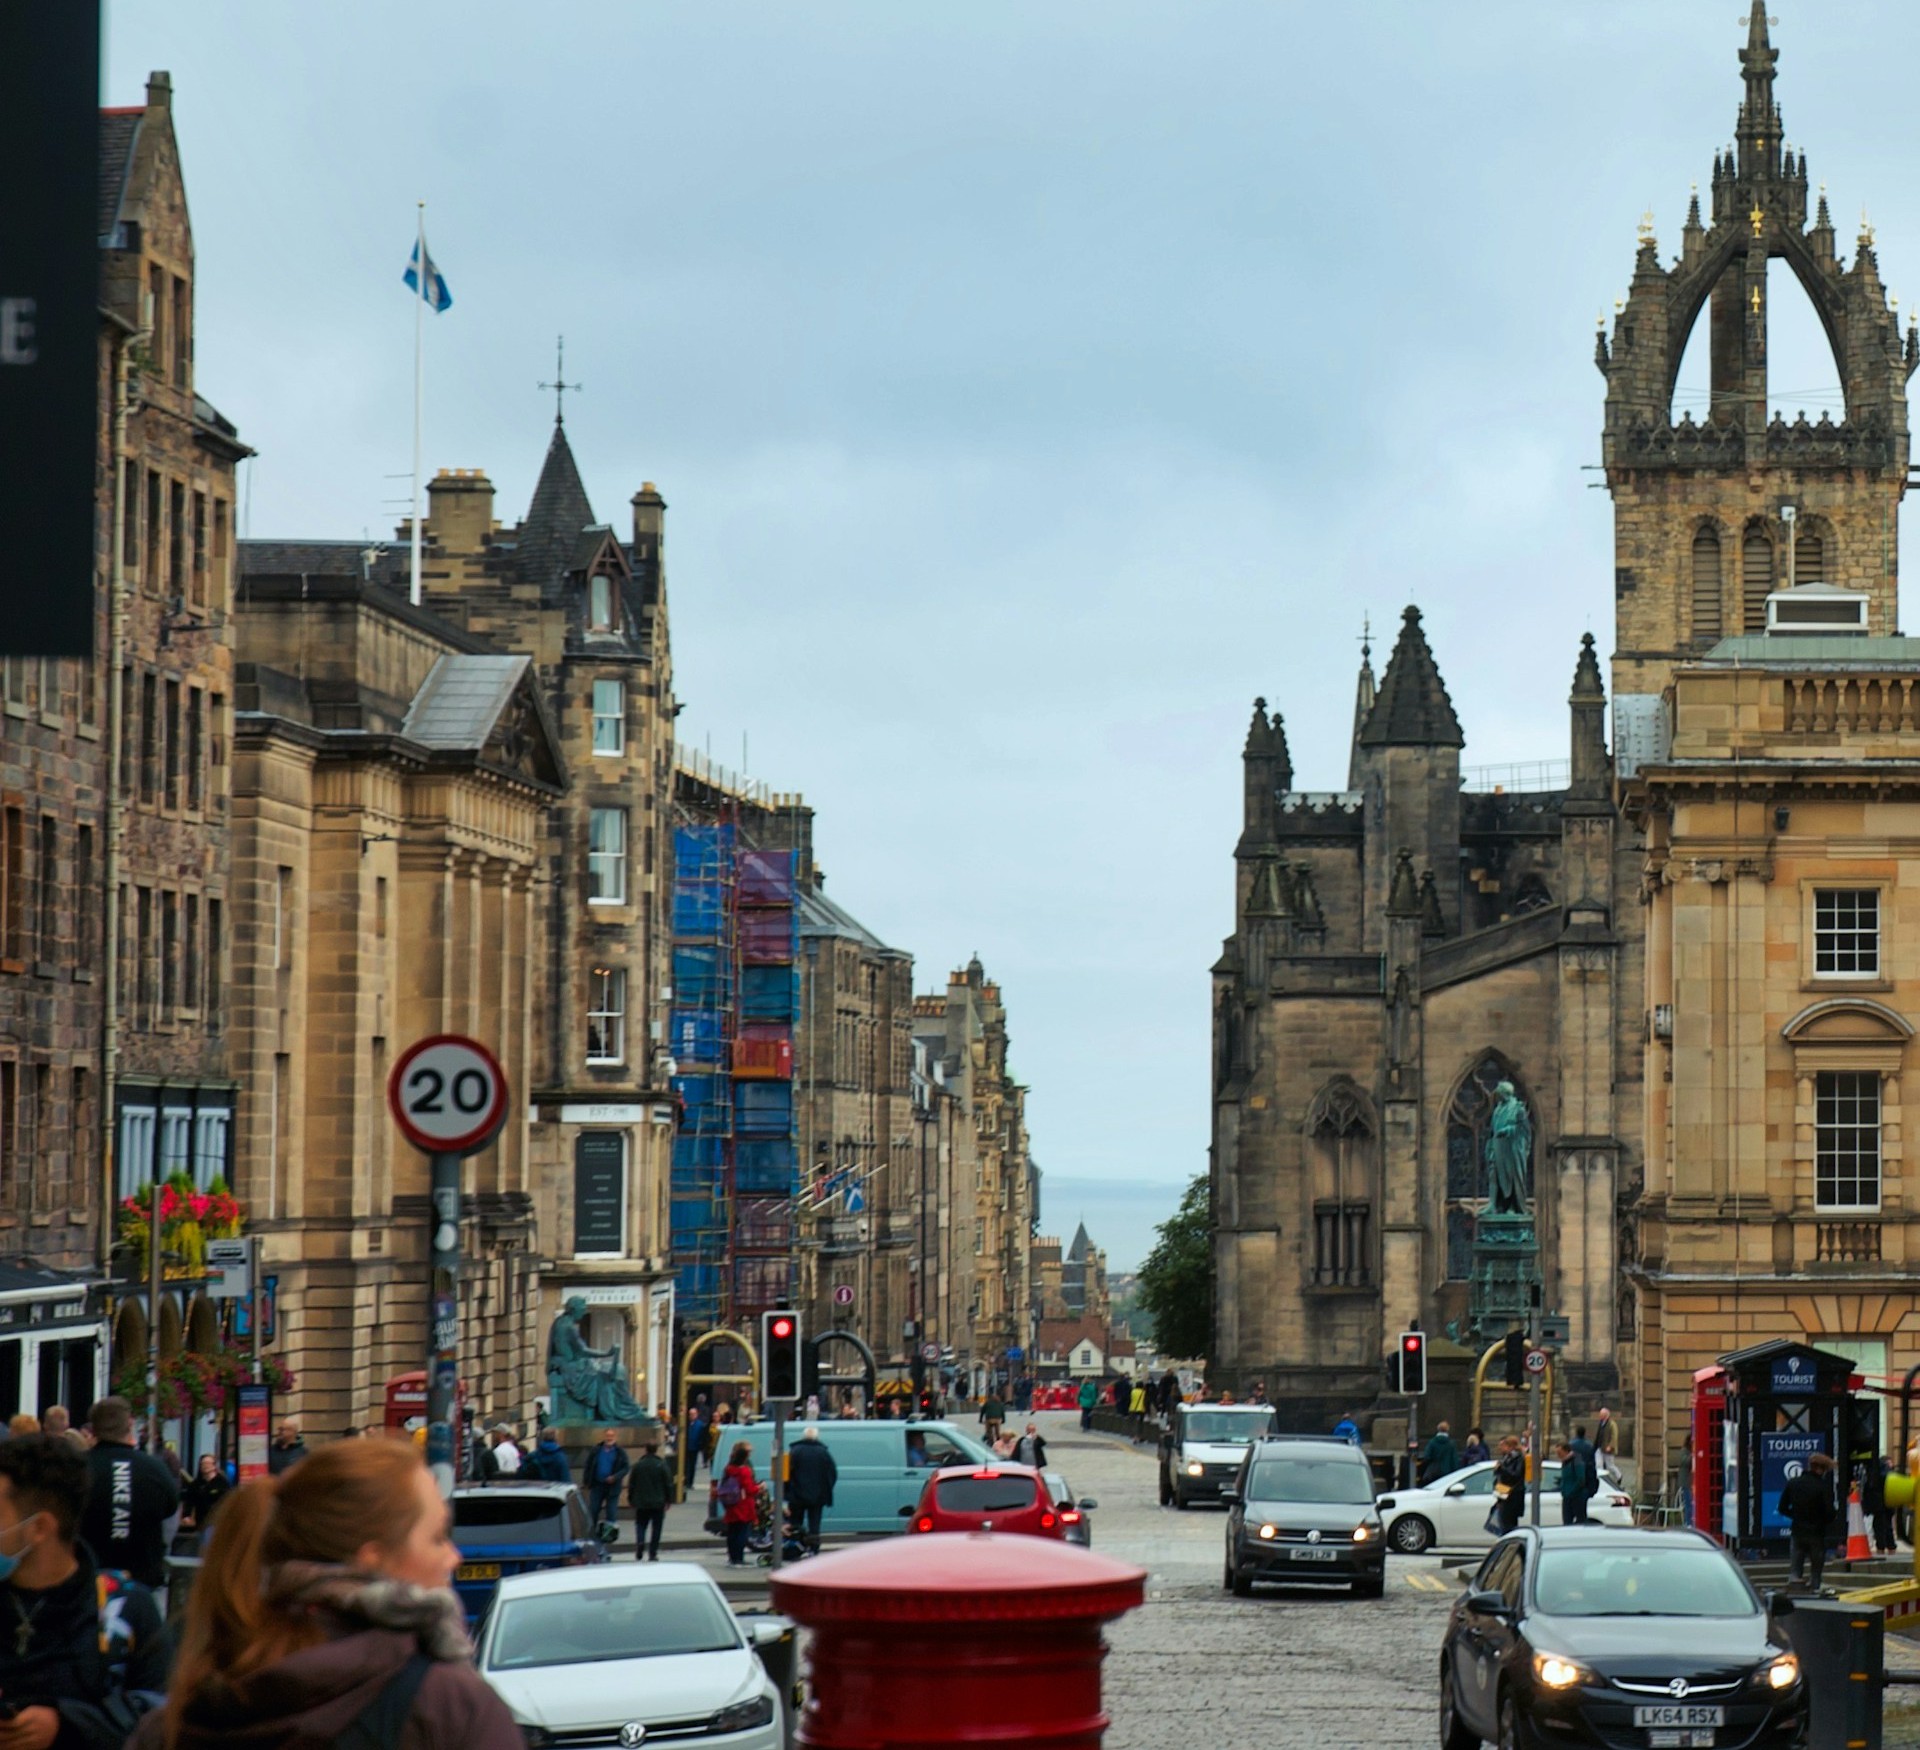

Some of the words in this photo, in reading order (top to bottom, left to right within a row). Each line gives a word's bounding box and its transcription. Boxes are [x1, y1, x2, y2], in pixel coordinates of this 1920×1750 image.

[408, 1067, 488, 1115] 20
[1528, 1356, 1544, 1367] 20
[1773, 1374, 1815, 1385] TOURIST
[1768, 1439, 1819, 1451] TOURIST
[112, 1461, 131, 1504] NIKE
[111, 1506, 130, 1540] AIR
[1641, 1709, 1683, 1723] LK64
[1688, 1709, 1718, 1723] RSX
